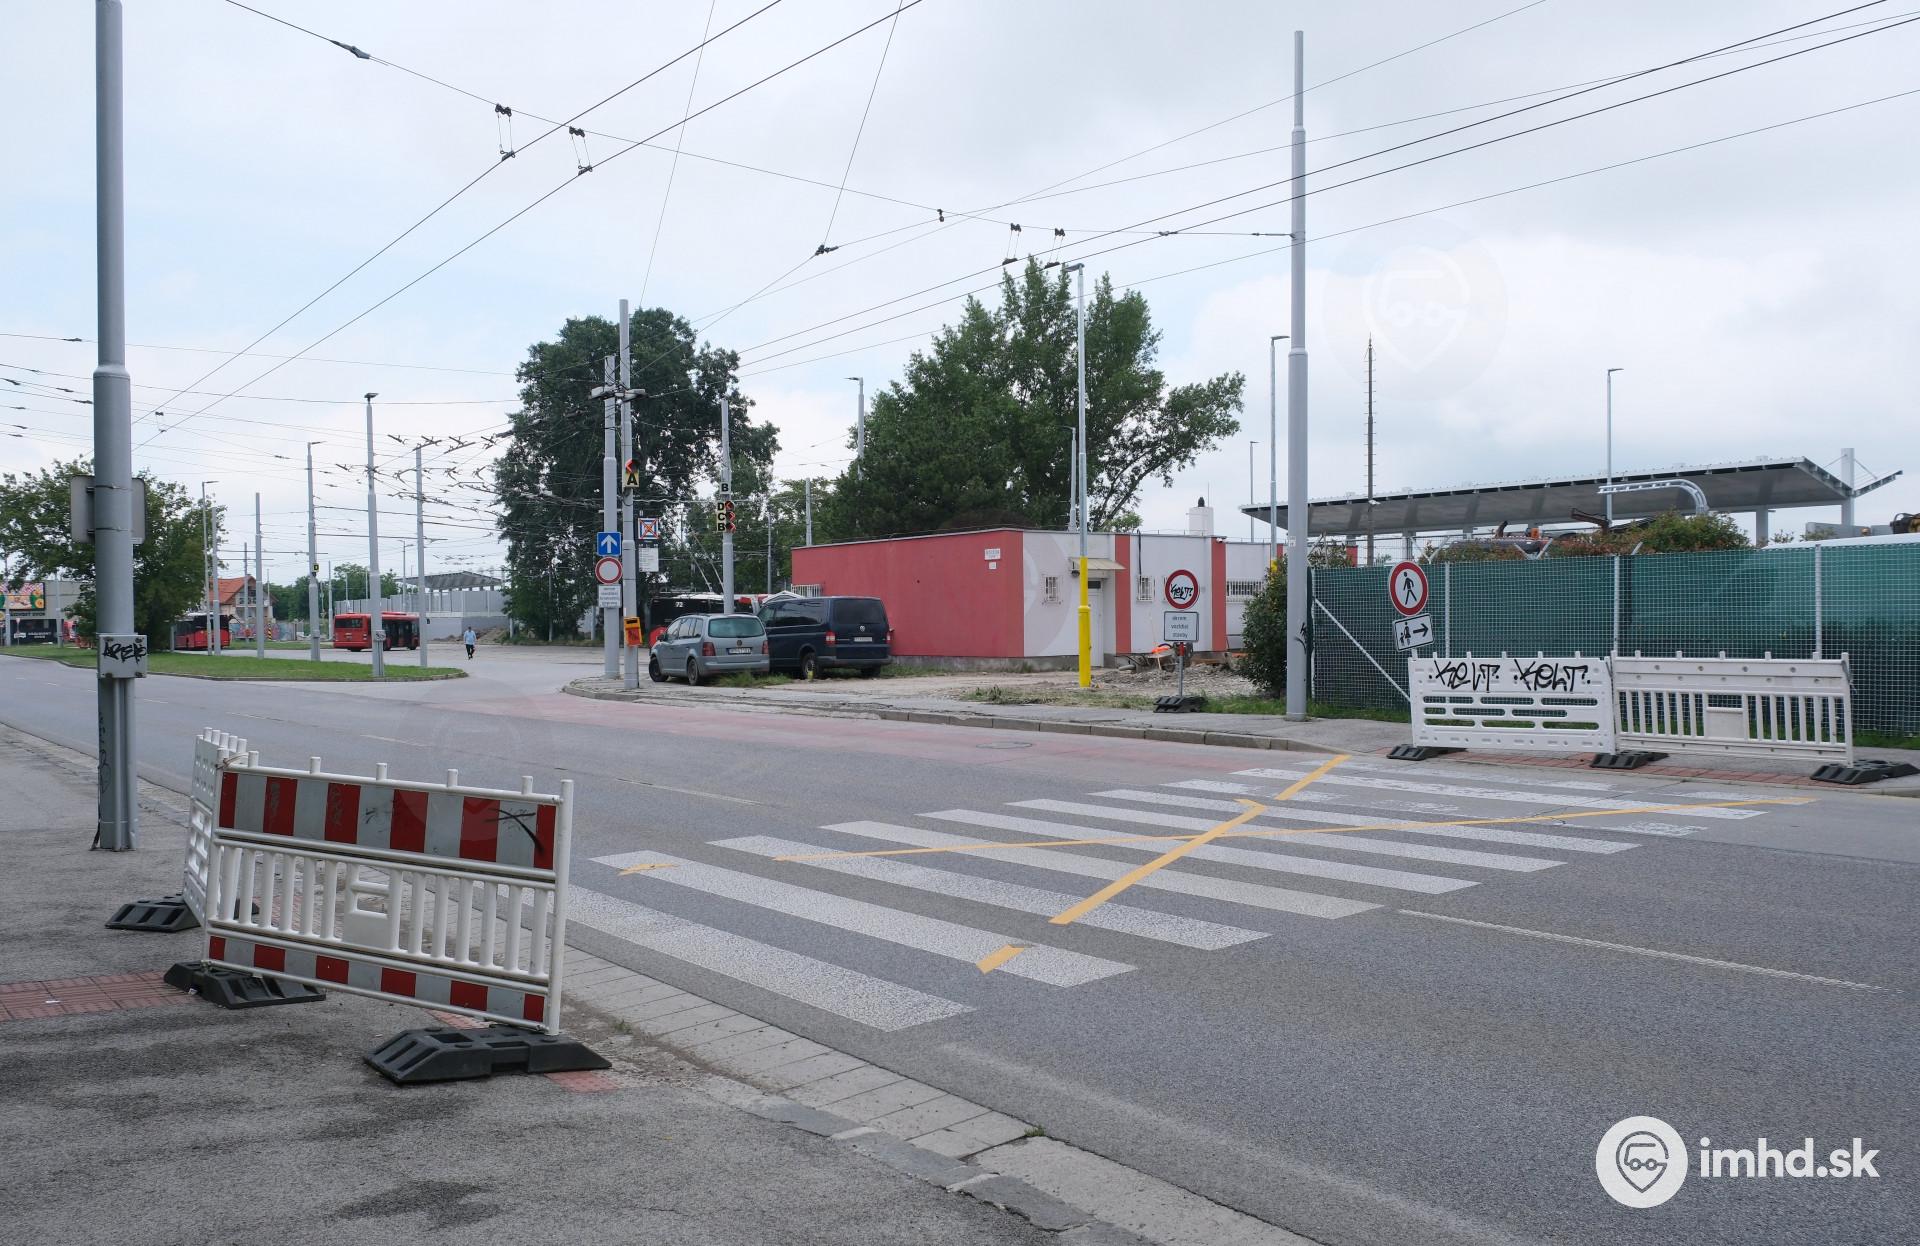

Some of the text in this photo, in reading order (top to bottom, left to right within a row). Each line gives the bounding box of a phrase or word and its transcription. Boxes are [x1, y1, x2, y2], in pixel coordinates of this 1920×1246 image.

[626, 473, 638, 486] A
[721, 483, 729, 493] B
[718, 502, 724, 511] D
[718, 512, 726, 521] C
[718, 522, 726, 532] B
